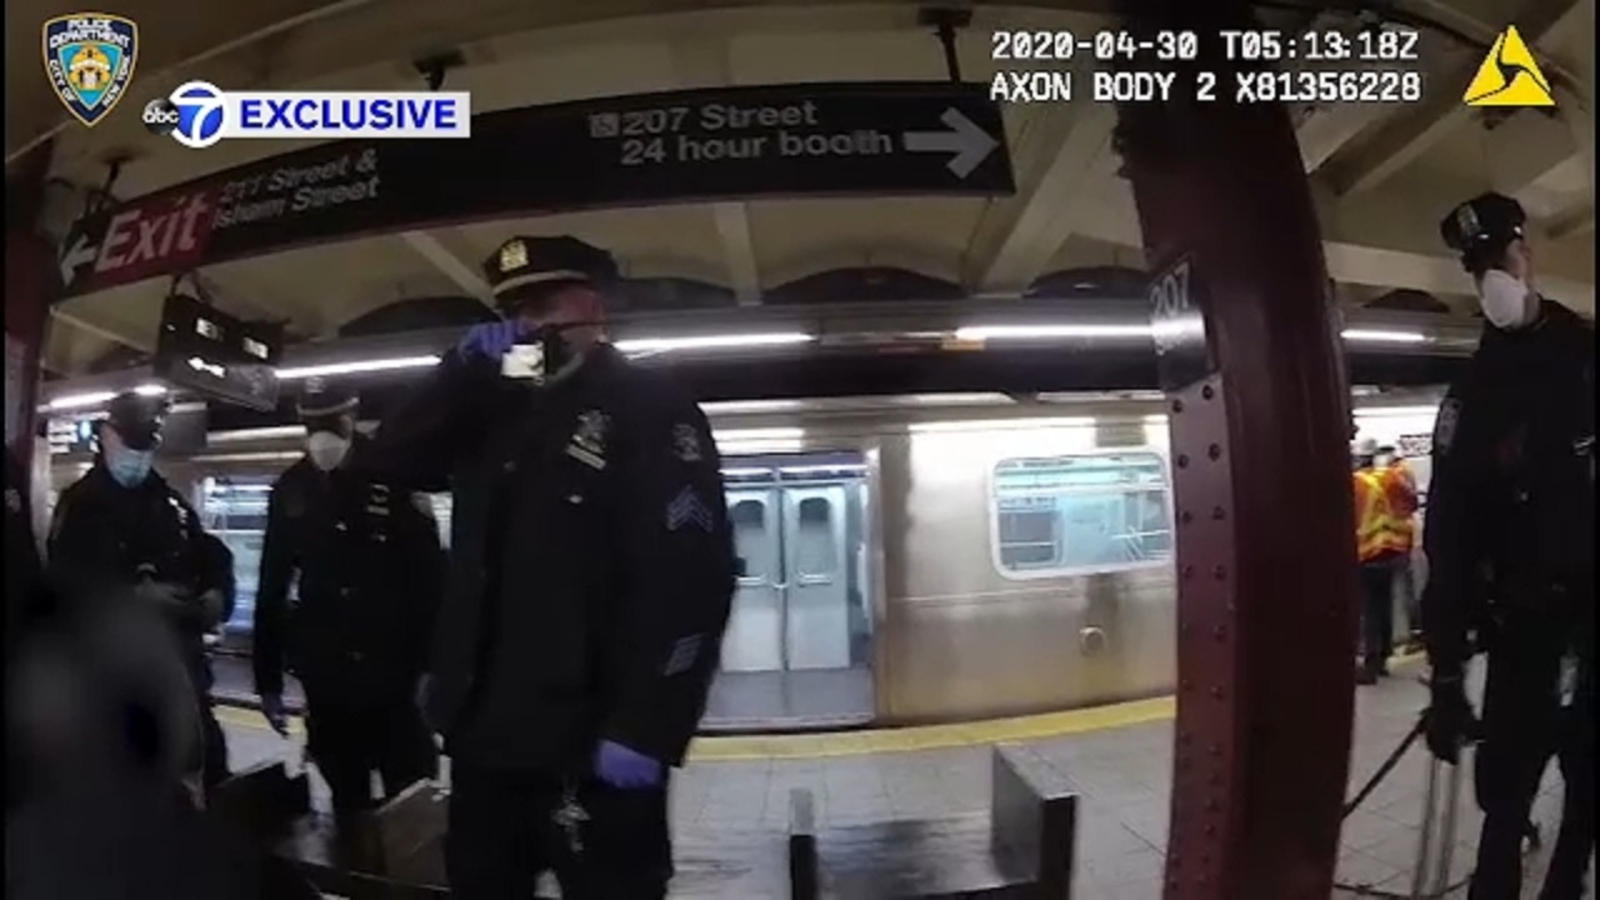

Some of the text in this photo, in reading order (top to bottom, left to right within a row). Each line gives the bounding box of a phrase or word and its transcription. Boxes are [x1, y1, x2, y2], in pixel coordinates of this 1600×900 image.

[622, 101, 818, 137] 207 Street
[620, 129, 893, 166] 24 hour booth
[267, 154, 349, 191] Street
[355, 148, 378, 173] &
[291, 175, 380, 212] Street
[95, 190, 209, 273] Exit
